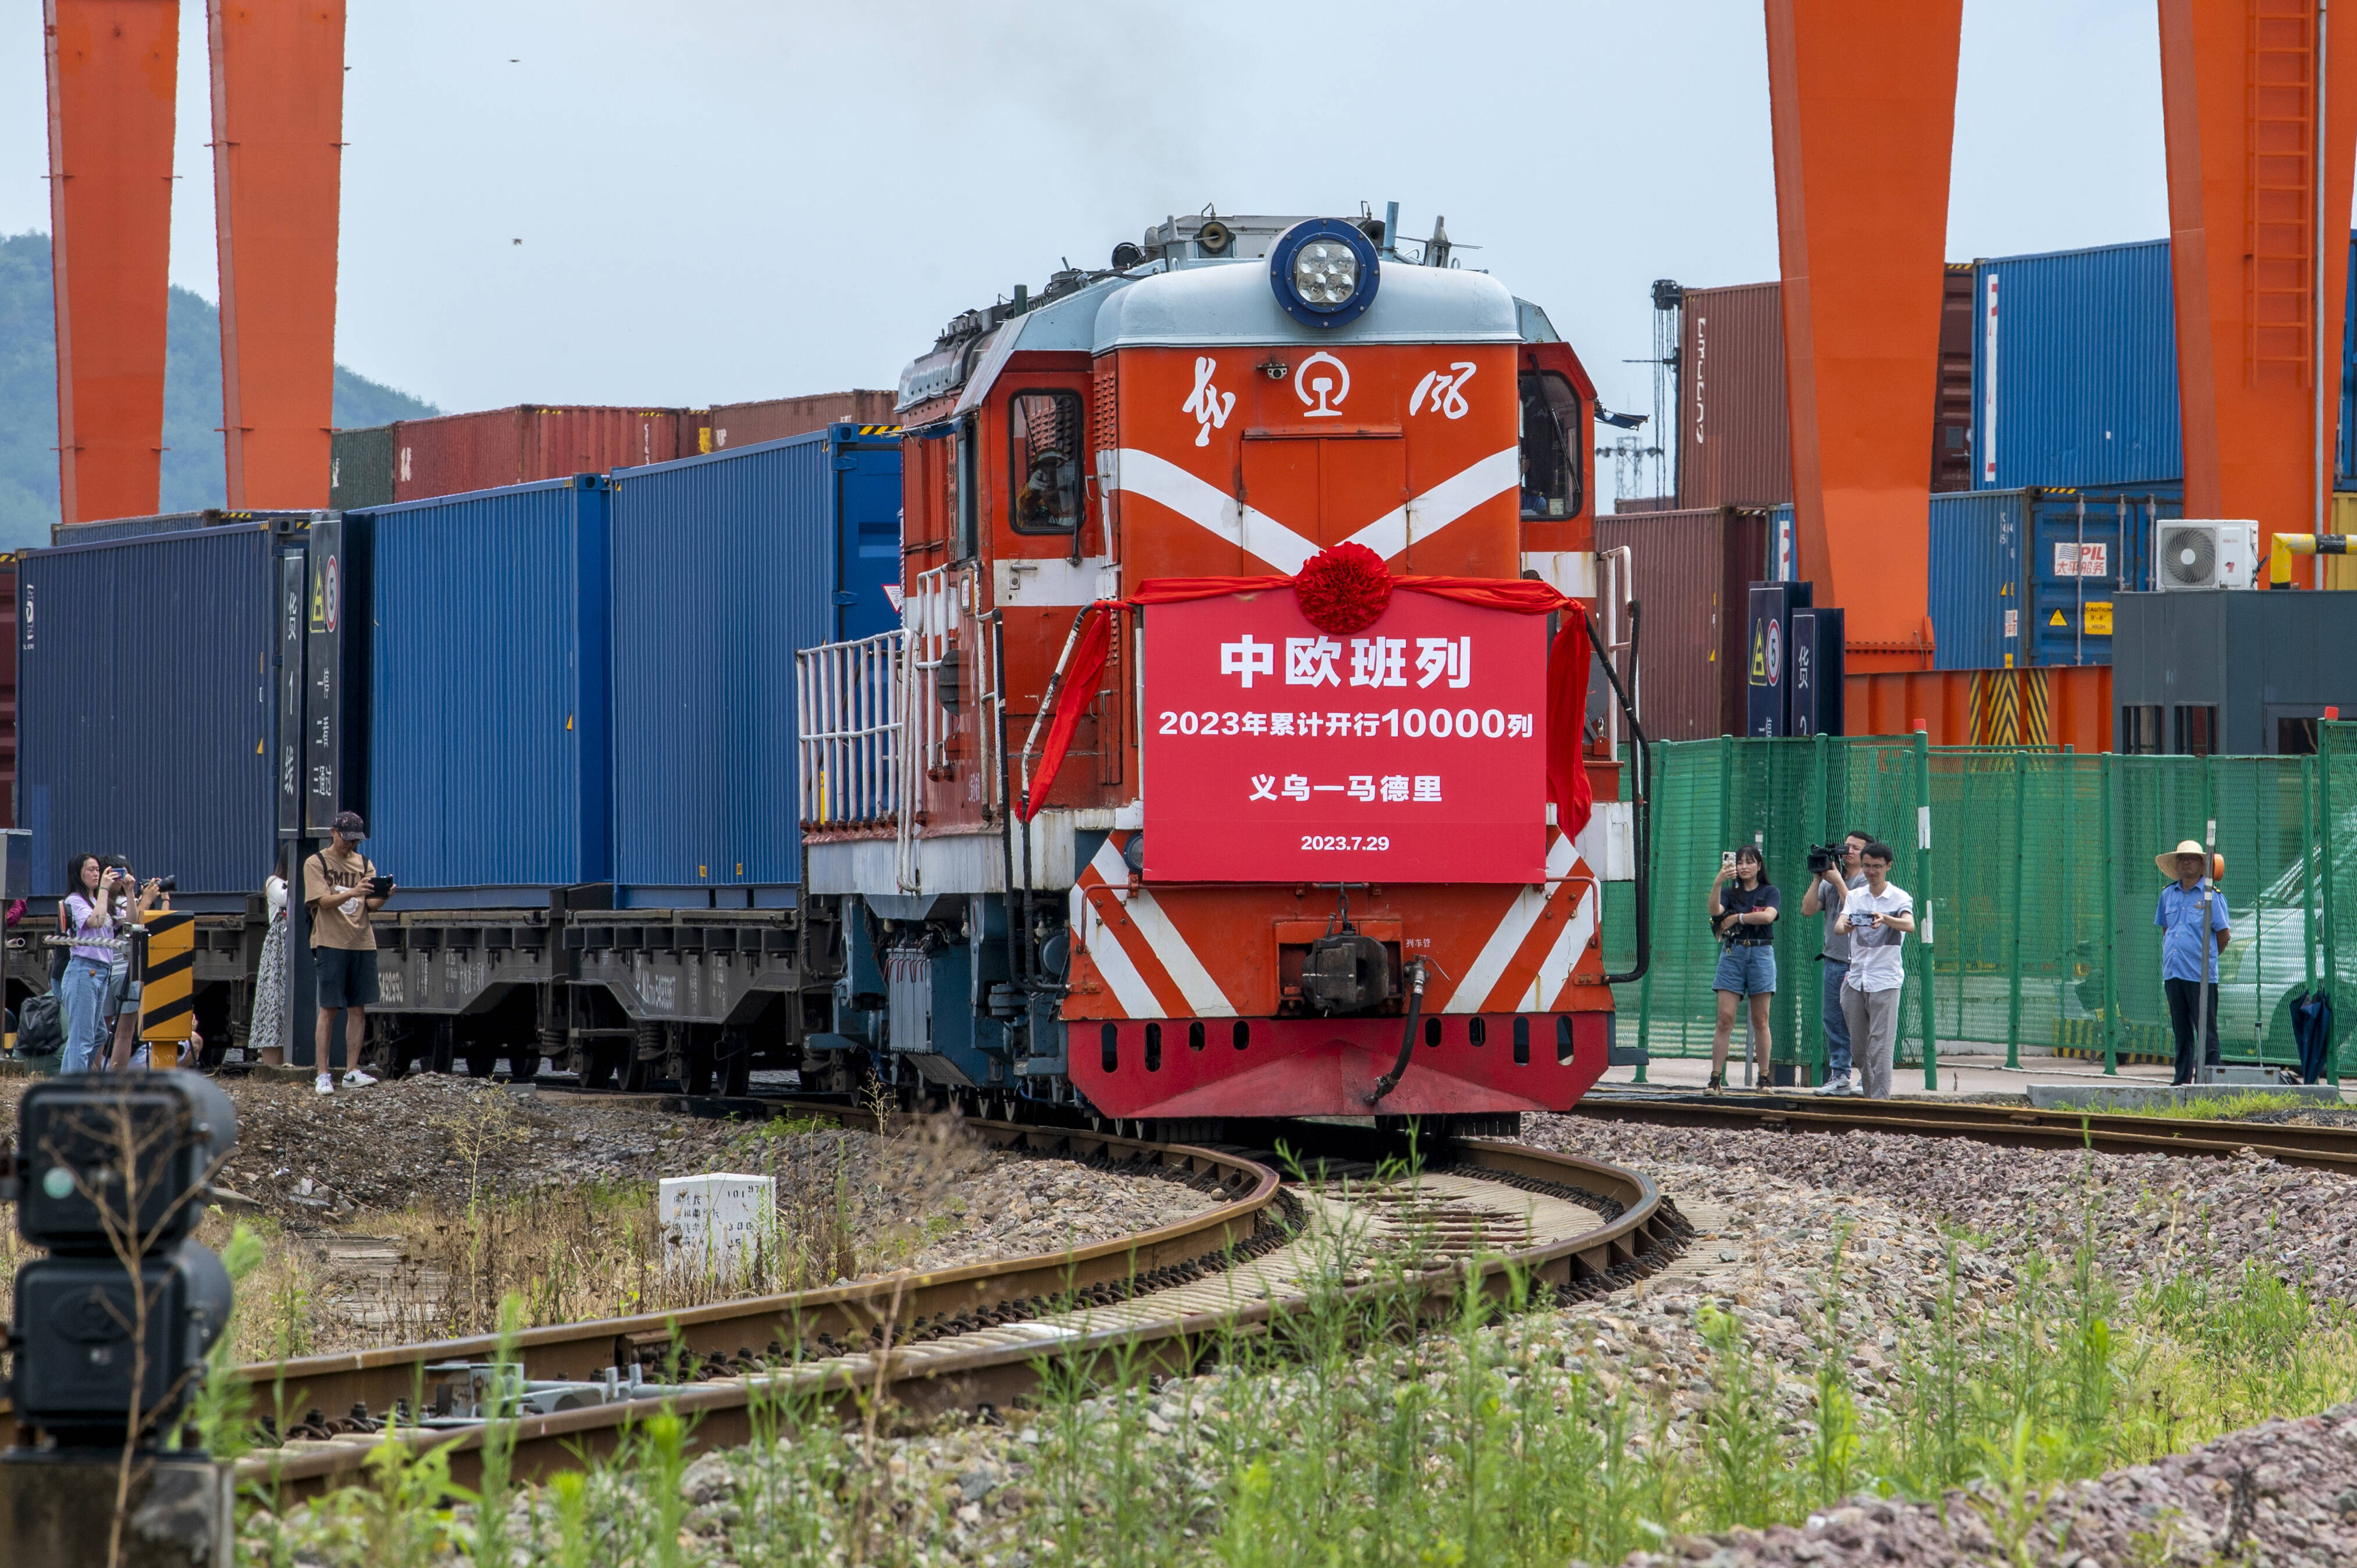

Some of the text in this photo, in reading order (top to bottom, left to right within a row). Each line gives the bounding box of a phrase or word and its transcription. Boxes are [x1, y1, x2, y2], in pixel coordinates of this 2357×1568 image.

[2081, 546, 2105, 561] PIL
[2056, 561, 2105, 575] 太平船务
[329, 577, 336, 610] 5
[1220, 634, 1471, 689] 中欧班列
[1771, 638, 1776, 668] 5
[1159, 708, 1533, 739] 2023年累计开行10000列
[1301, 836, 1390, 851] 2023.7.29
[326, 869, 365, 888] SMIL
